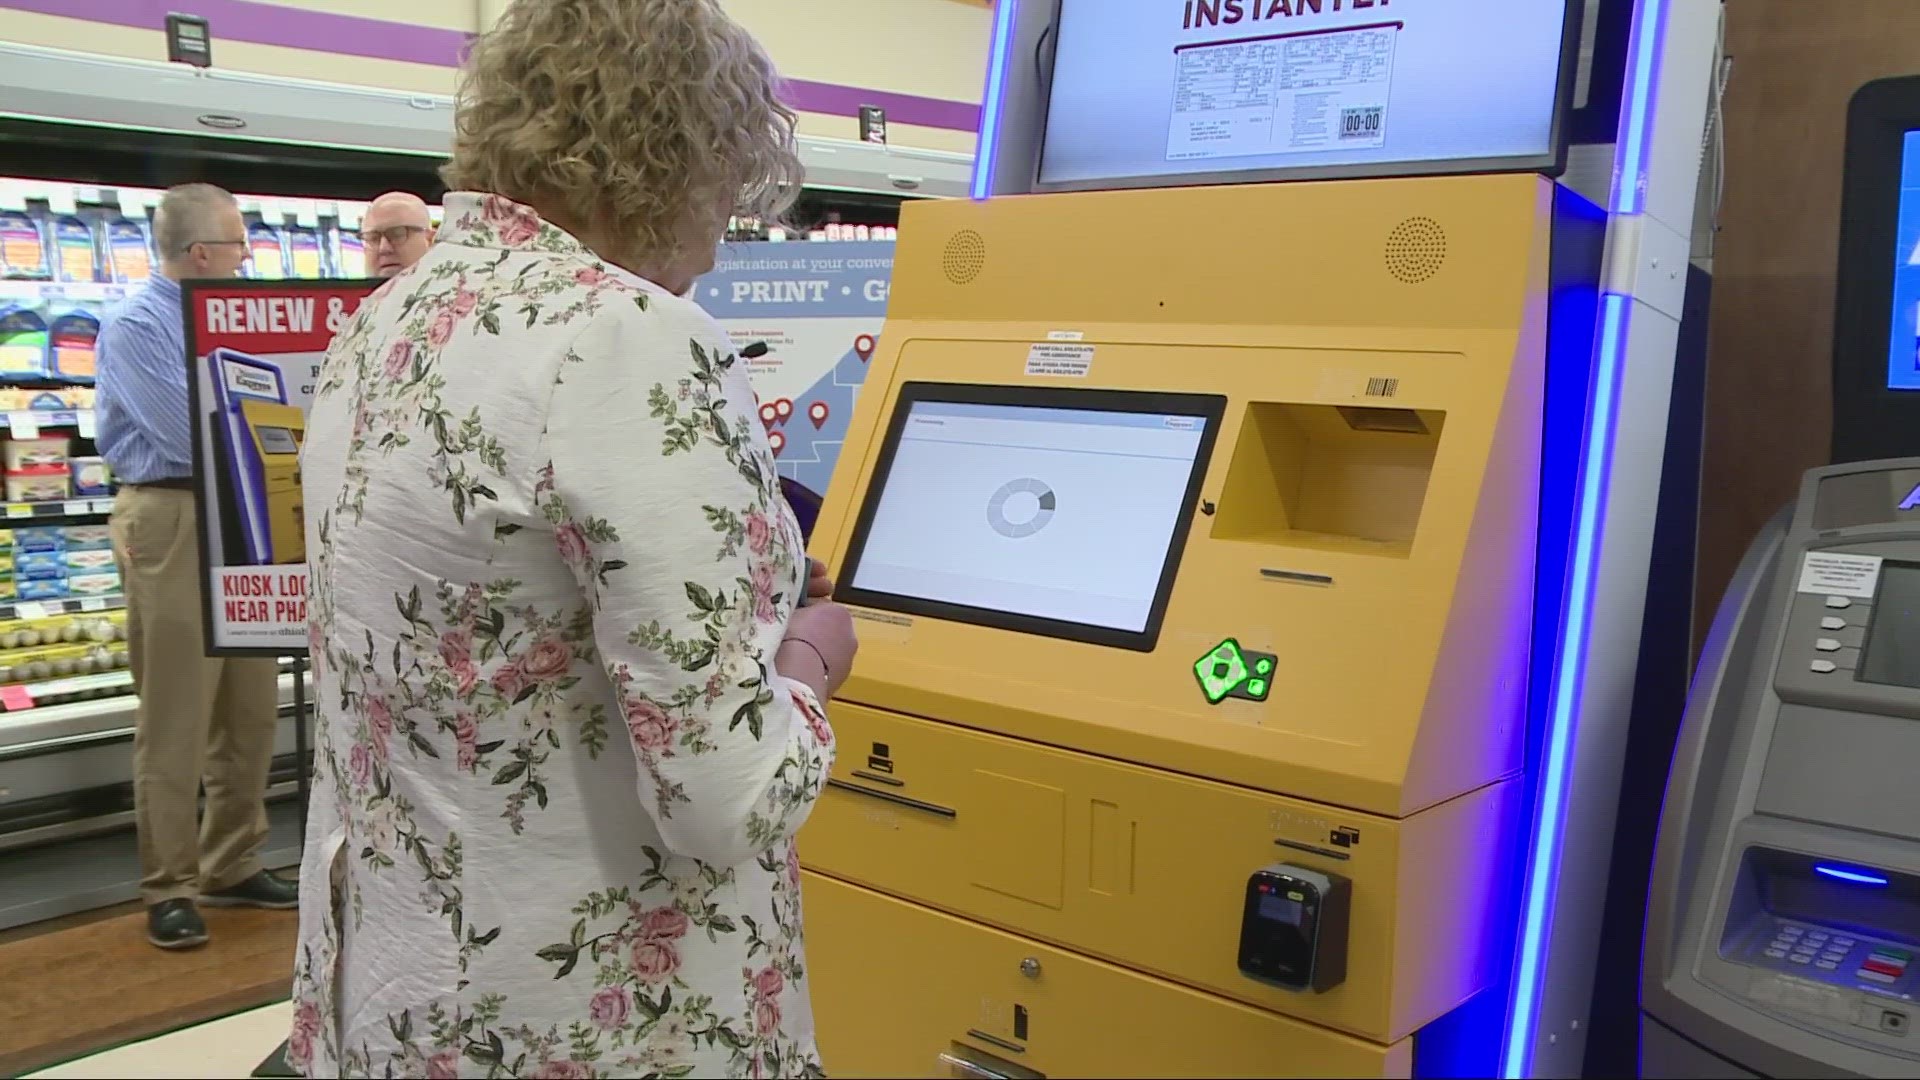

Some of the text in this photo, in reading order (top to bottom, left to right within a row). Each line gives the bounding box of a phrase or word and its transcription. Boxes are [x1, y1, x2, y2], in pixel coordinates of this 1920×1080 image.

[792, 258, 807, 270] at
[811, 258, 843, 273] your
[847, 257, 894, 269] conve
[731, 280, 891, 303] PRINT G
[206, 297, 315, 334] RENEW
[223, 575, 273, 596] KIOSK
[225, 601, 269, 622] NEAR
